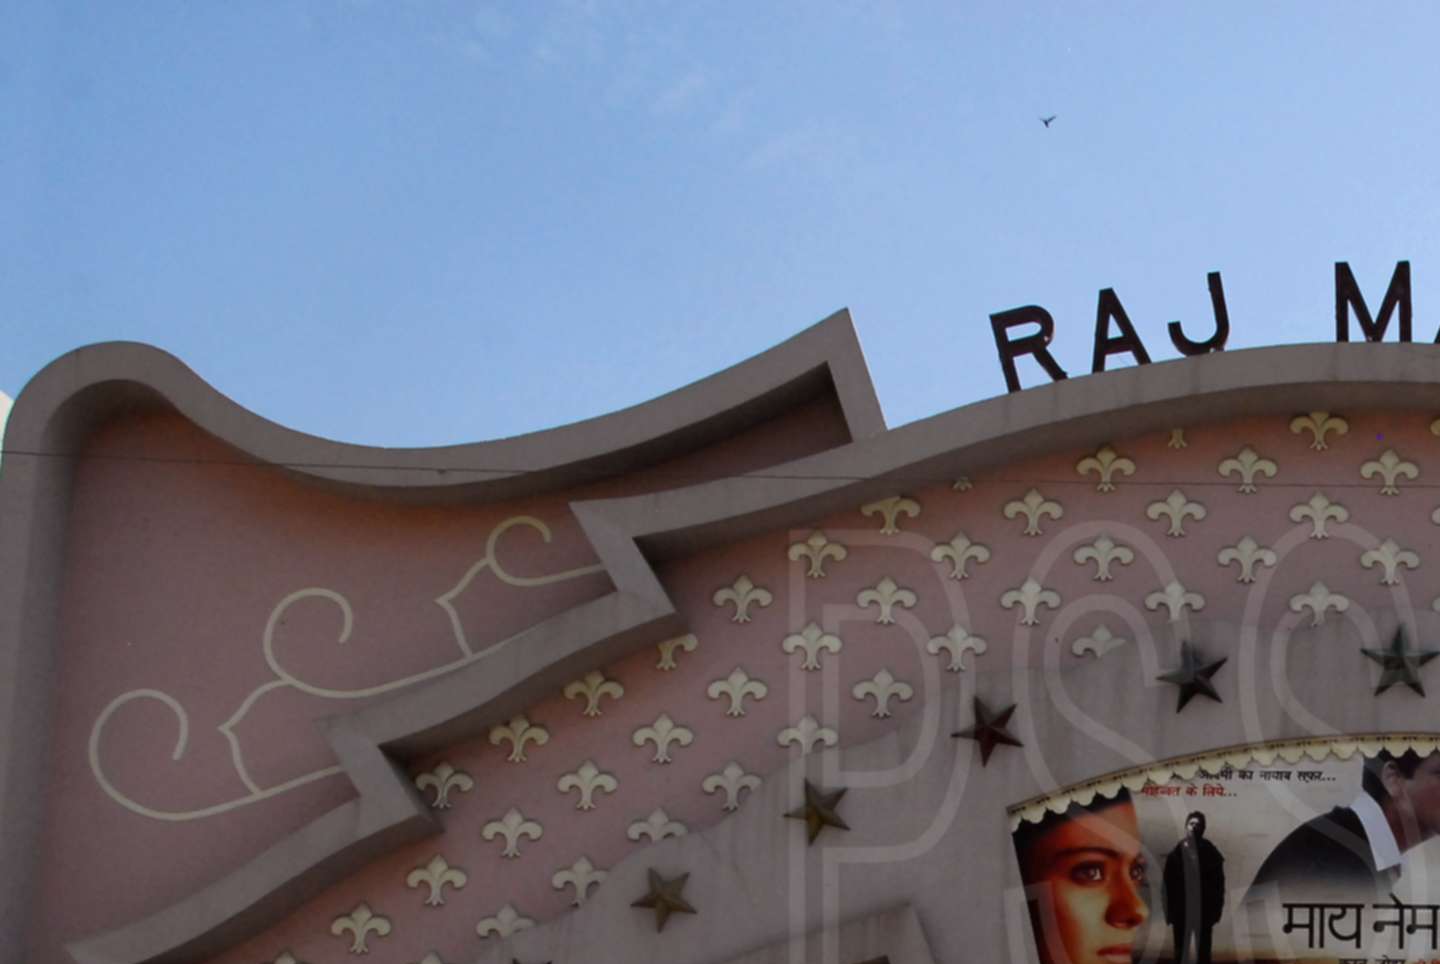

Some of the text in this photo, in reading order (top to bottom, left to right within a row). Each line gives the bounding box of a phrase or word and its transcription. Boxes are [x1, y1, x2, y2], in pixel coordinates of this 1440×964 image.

[989, 271, 1230, 394] RAJ
[1282, 903, 1364, 949] माय
[1372, 892, 1440, 950] नेम
